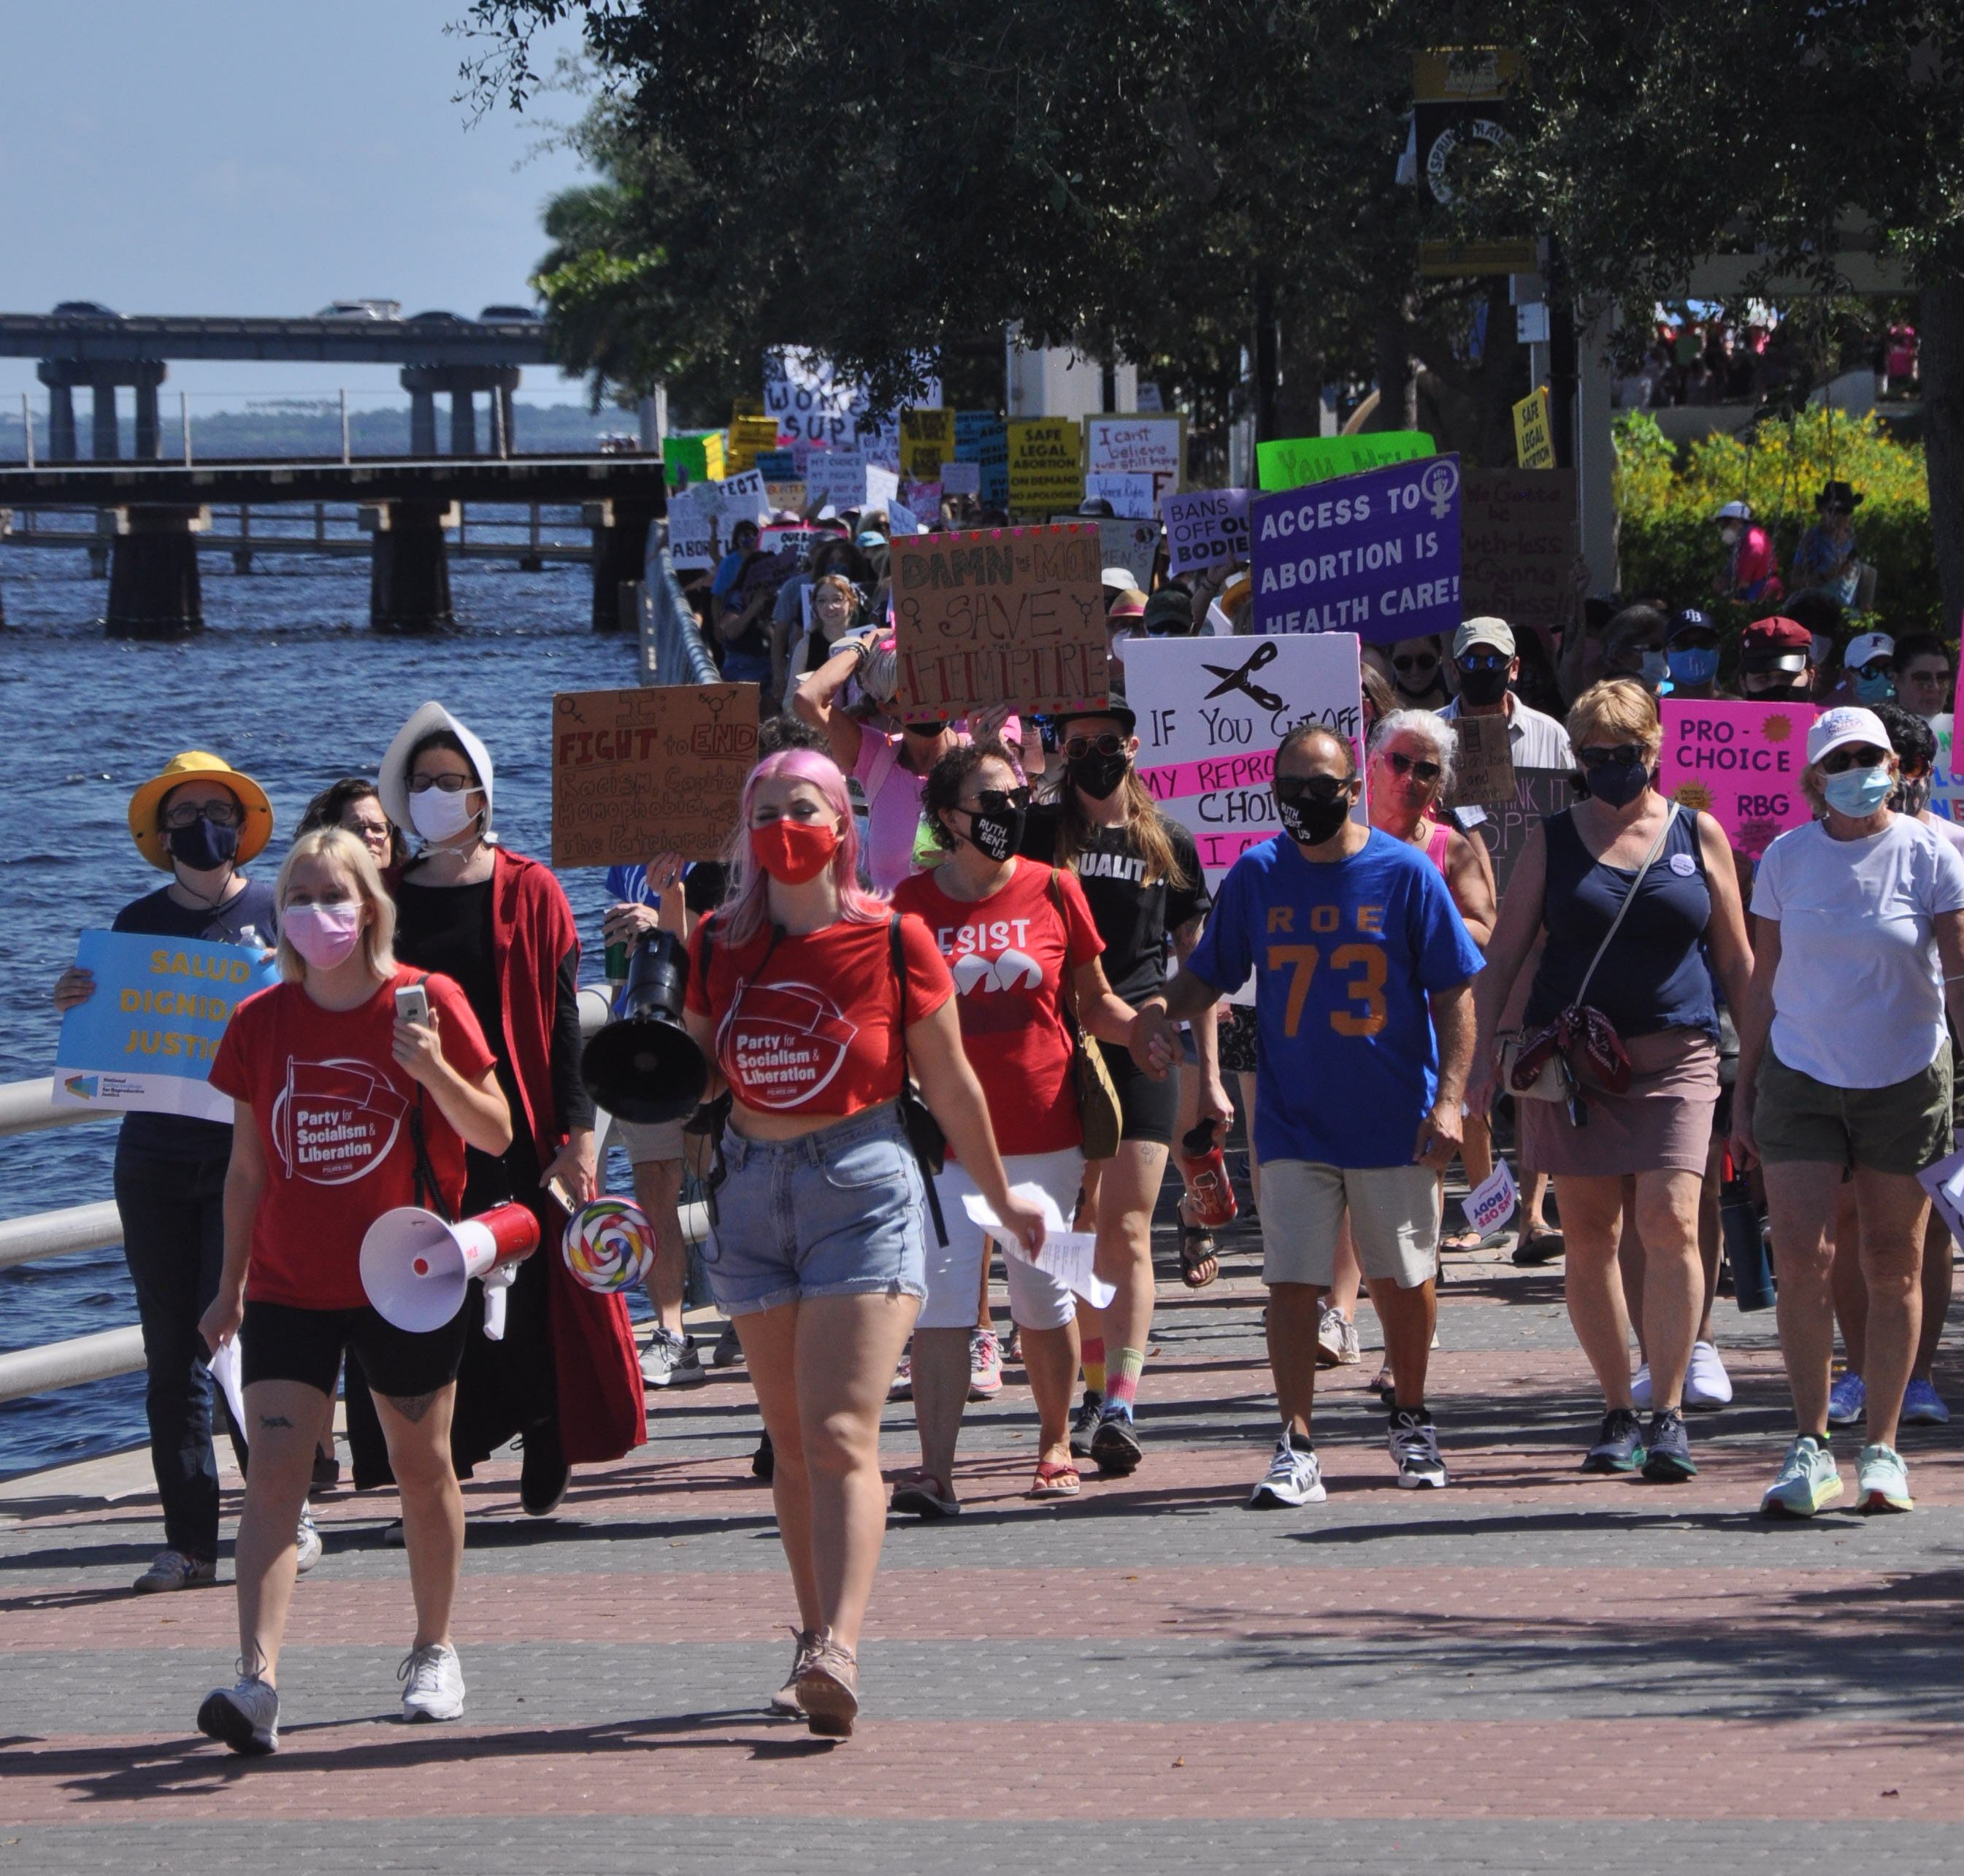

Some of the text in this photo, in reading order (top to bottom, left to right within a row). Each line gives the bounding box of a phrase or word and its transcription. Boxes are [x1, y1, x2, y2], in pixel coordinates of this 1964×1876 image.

[1025, 428, 1062, 441] SAFE
[1019, 444, 1067, 456] LEGAL
[1109, 445, 1167, 459] believe
[1013, 459, 1075, 469] ABORTION
[1010, 475, 1080, 486] ON DEMAND
[1171, 498, 1229, 523] BANS
[1261, 484, 1420, 542] ACCESS TO
[1175, 520, 1216, 542] OFF
[1221, 518, 1249, 534] OU
[1176, 537, 1249, 563] BODIE
[901, 545, 1014, 590] DAMN
[1260, 531, 1438, 595] ABORTION IS
[938, 588, 1063, 641] SAVE
[1265, 575, 1460, 635] HEALTH CARE!
[1681, 608, 1702, 622] TB
[1150, 709, 1176, 747] IF
[1199, 707, 1253, 745] YOU
[559, 723, 758, 765] FIGHT to END
[1676, 745, 1791, 772] CHOICE
[1198, 791, 1276, 824] CHOI
[978, 818, 1007, 838] RUTH
[1297, 828, 1311, 839] US
[980, 833, 1009, 850] SENT
[991, 847, 1006, 859] US
[1267, 905, 1386, 934] ROE
[938, 919, 1031, 956] ESIST
[150, 950, 251, 984] SALUD
[1267, 943, 1387, 1038] 73
[120, 988, 236, 1022] DIGNID
[736, 1034, 796, 1050] Party for
[736, 1048, 820, 1069] Socialism &
[741, 1066, 816, 1085] Liberation
[296, 1109, 353, 1127] Party for
[296, 1123, 376, 1145] Socialism &
[298, 1142, 372, 1164] Liberation
